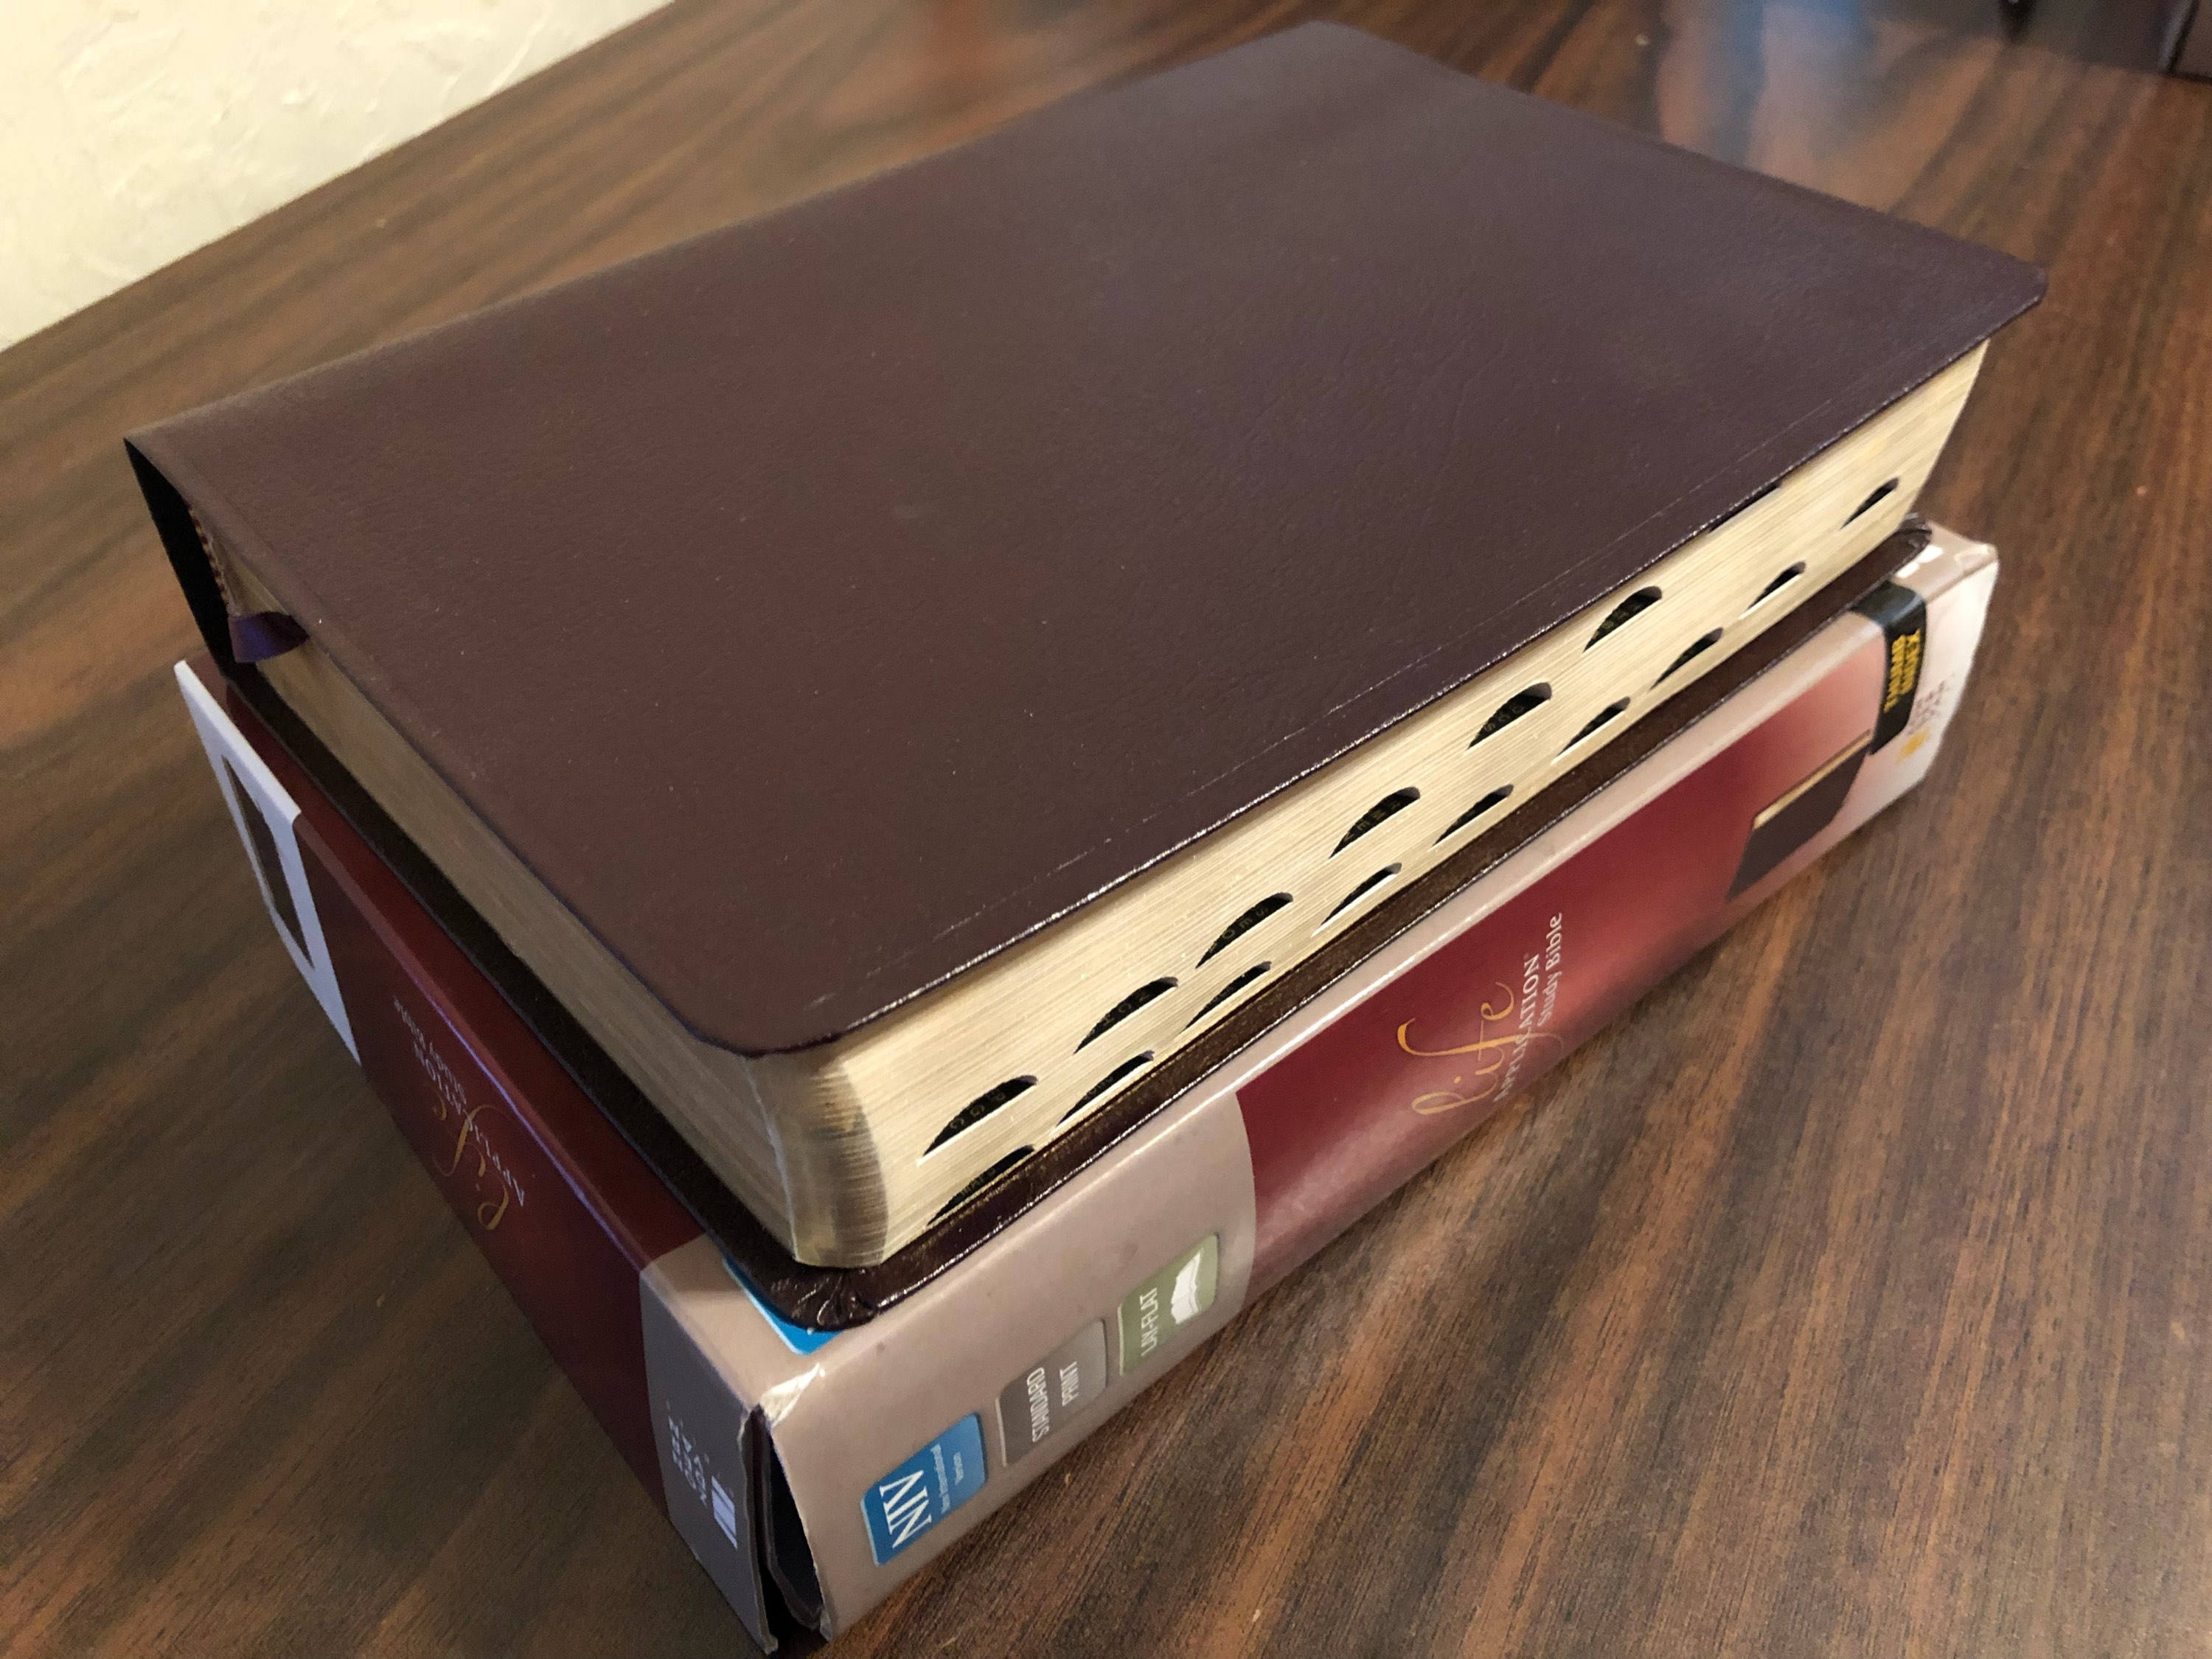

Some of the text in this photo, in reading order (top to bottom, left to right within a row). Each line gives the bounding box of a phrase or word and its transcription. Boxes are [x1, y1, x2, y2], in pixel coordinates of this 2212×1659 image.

[1537, 912, 1562, 1026] Study Bible
[1397, 981, 1564, 1116] Life
[1492, 953, 1540, 1102] APPLICATION
[1139, 1287, 1158, 1357] LAY-FLAT
[1026, 1366, 1050, 1442] STANDARD
[1060, 1361, 1078, 1407] PRINT
[879, 1470, 932, 1549] NIV
